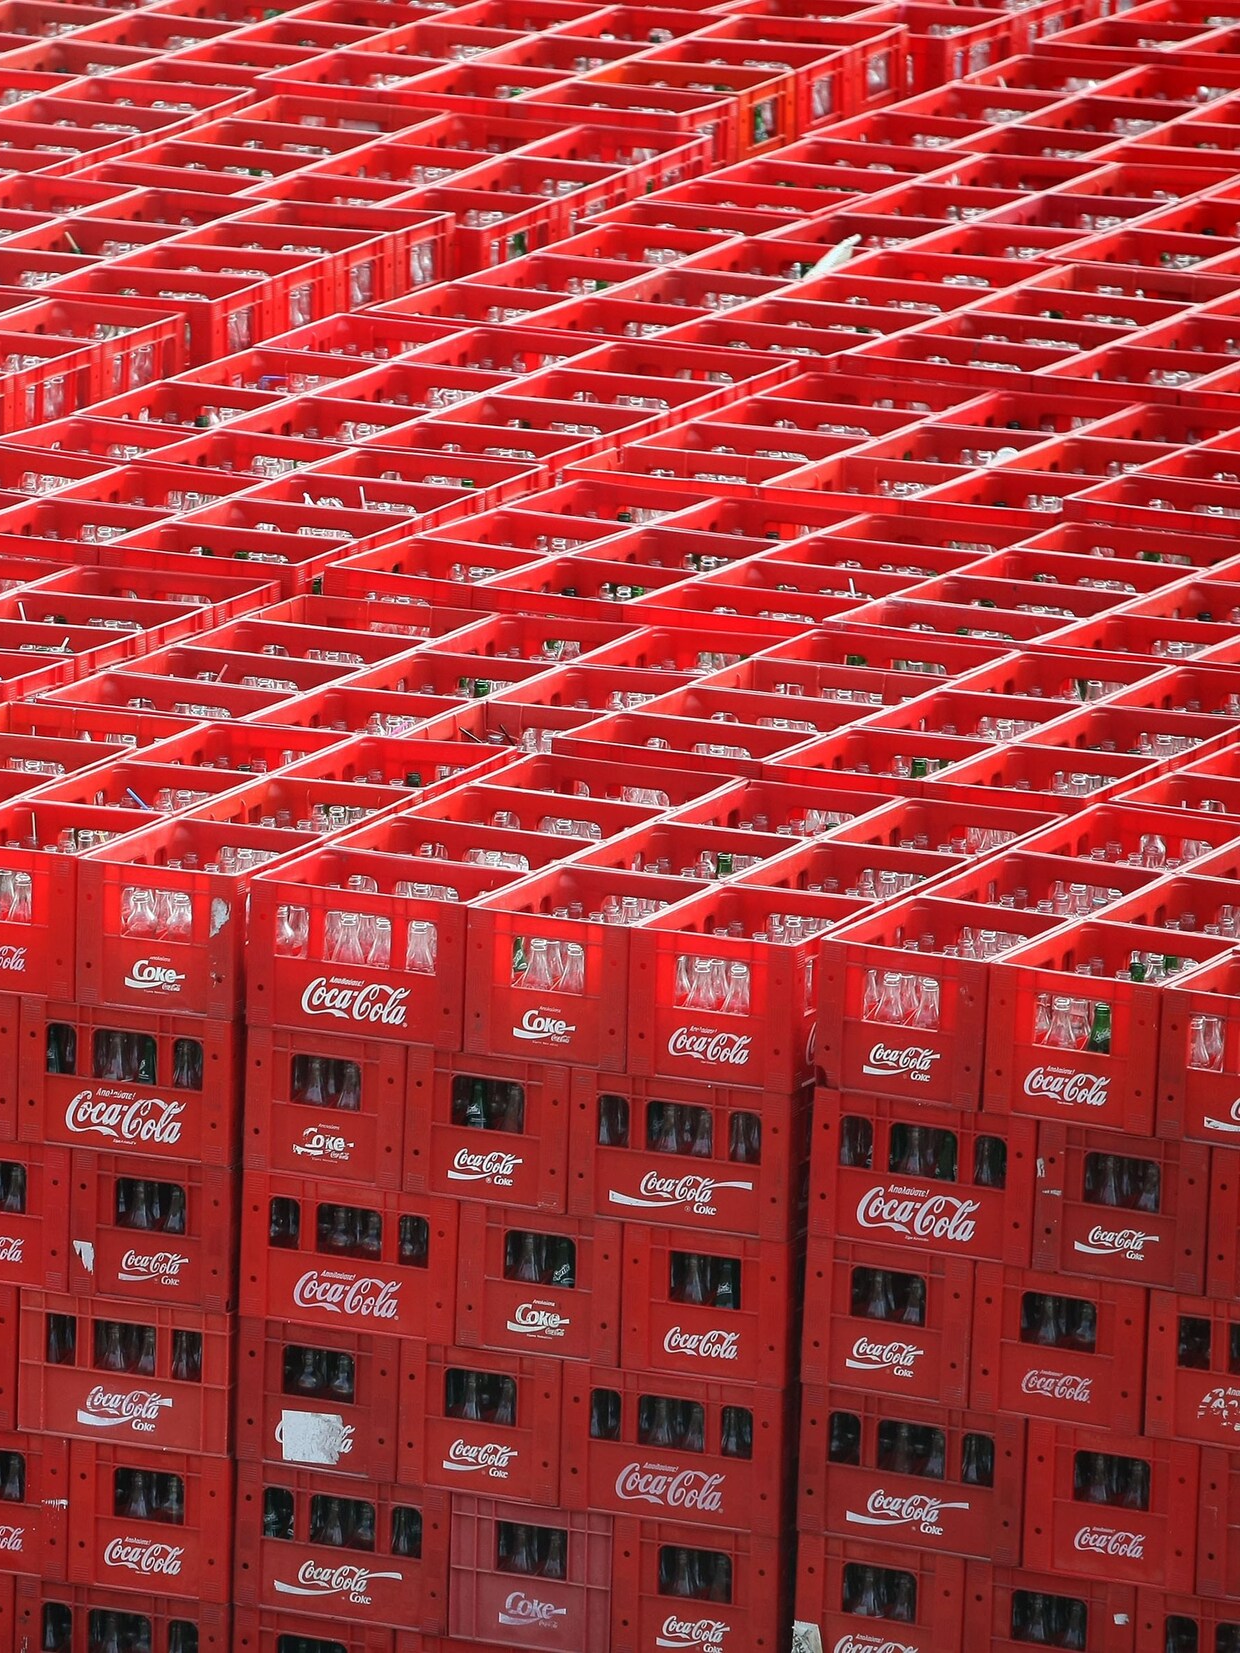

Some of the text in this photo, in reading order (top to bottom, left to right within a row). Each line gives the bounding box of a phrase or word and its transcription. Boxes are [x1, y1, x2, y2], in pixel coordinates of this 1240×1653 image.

[133, 960, 176, 984] Coke
[302, 976, 410, 1026] Coca-Cola
[522, 1010, 567, 1033] Coke
[668, 1026, 750, 1065] Coca-Cola
[870, 1043, 931, 1070] Coca-Cola
[1024, 1067, 1111, 1106] Coca-Cola
[65, 1090, 187, 1144] Coca-Cola
[454, 1148, 514, 1174] Coca-Cola
[640, 1172, 713, 1203] Coca-Cola
[857, 1186, 980, 1241] Coca-Cola
[1088, 1225, 1143, 1251] Coca-Cola
[121, 1250, 180, 1275] Coca-Cola
[293, 1271, 402, 1319] Coca-Cola
[515, 1304, 561, 1327] Coke
[664, 1326, 739, 1360] Coca-Cola
[853, 1337, 915, 1366] Coca-Cola
[1022, 1370, 1092, 1402] Coca-Cola
[86, 1385, 160, 1420] Coca-Cola
[449, 1439, 510, 1467] Coca-Cola
[615, 1463, 726, 1512] Coca-Cola
[867, 1489, 939, 1522] Coca-Cola
[104, 1537, 182, 1575] Coca-Cola
[1074, 1527, 1145, 1559] Coca-Cola
[298, 1560, 367, 1591] Coca-Cola
[506, 1591, 554, 1619] Coke
[662, 1615, 725, 1641] Coca-Cola
